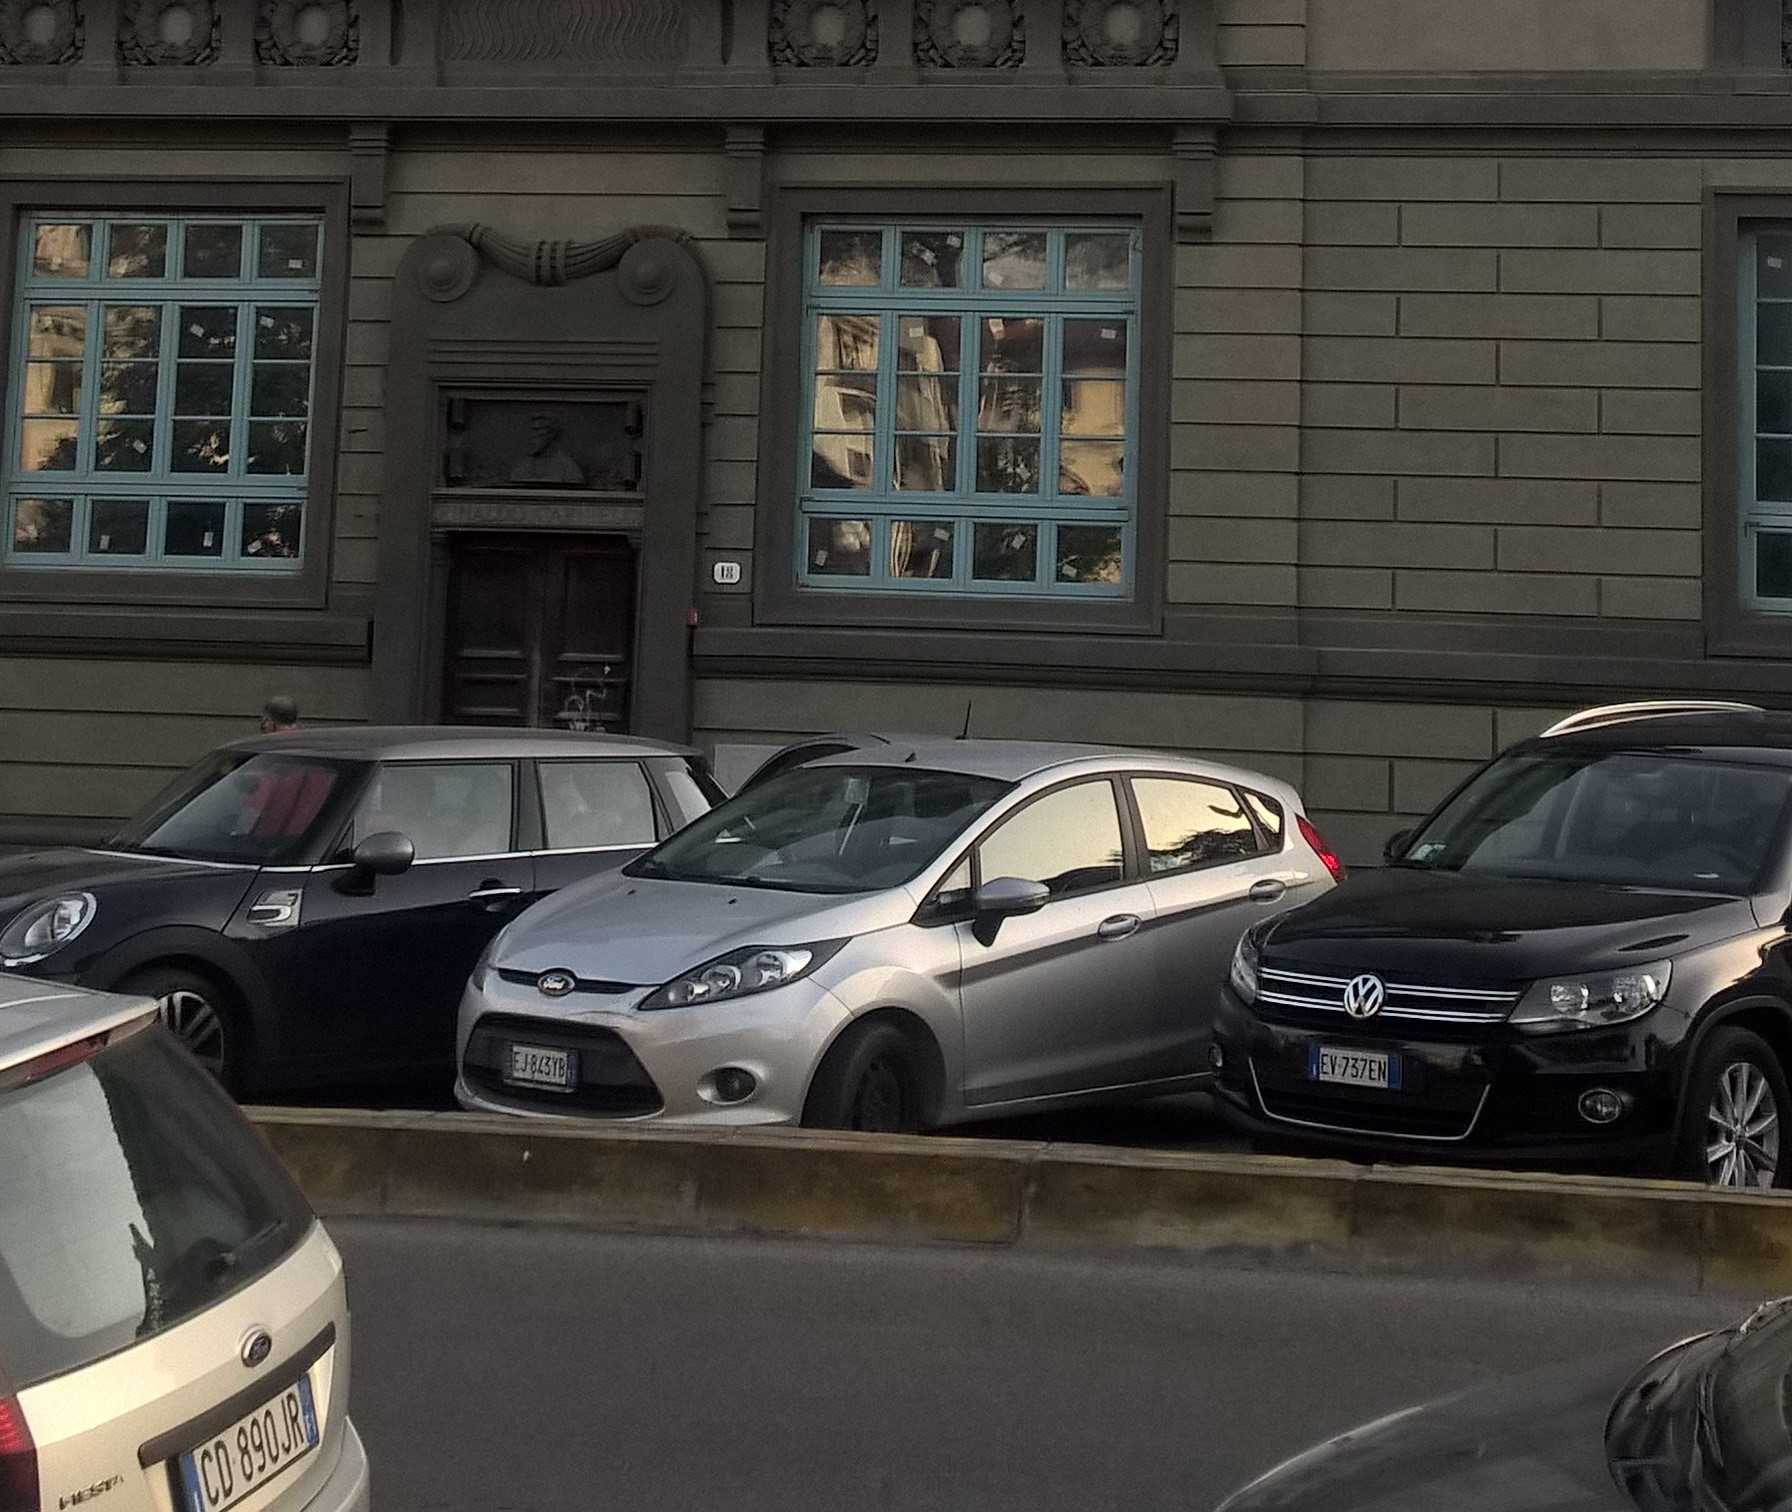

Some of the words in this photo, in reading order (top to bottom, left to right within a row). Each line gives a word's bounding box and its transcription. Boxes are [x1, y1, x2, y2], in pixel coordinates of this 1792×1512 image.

[721, 565, 734, 579] 18
[1320, 1053, 1337, 1077] EV
[1341, 1056, 1387, 1082] 737EN
[200, 1439, 234, 1507] CD
[236, 1392, 305, 1482] 890JR
